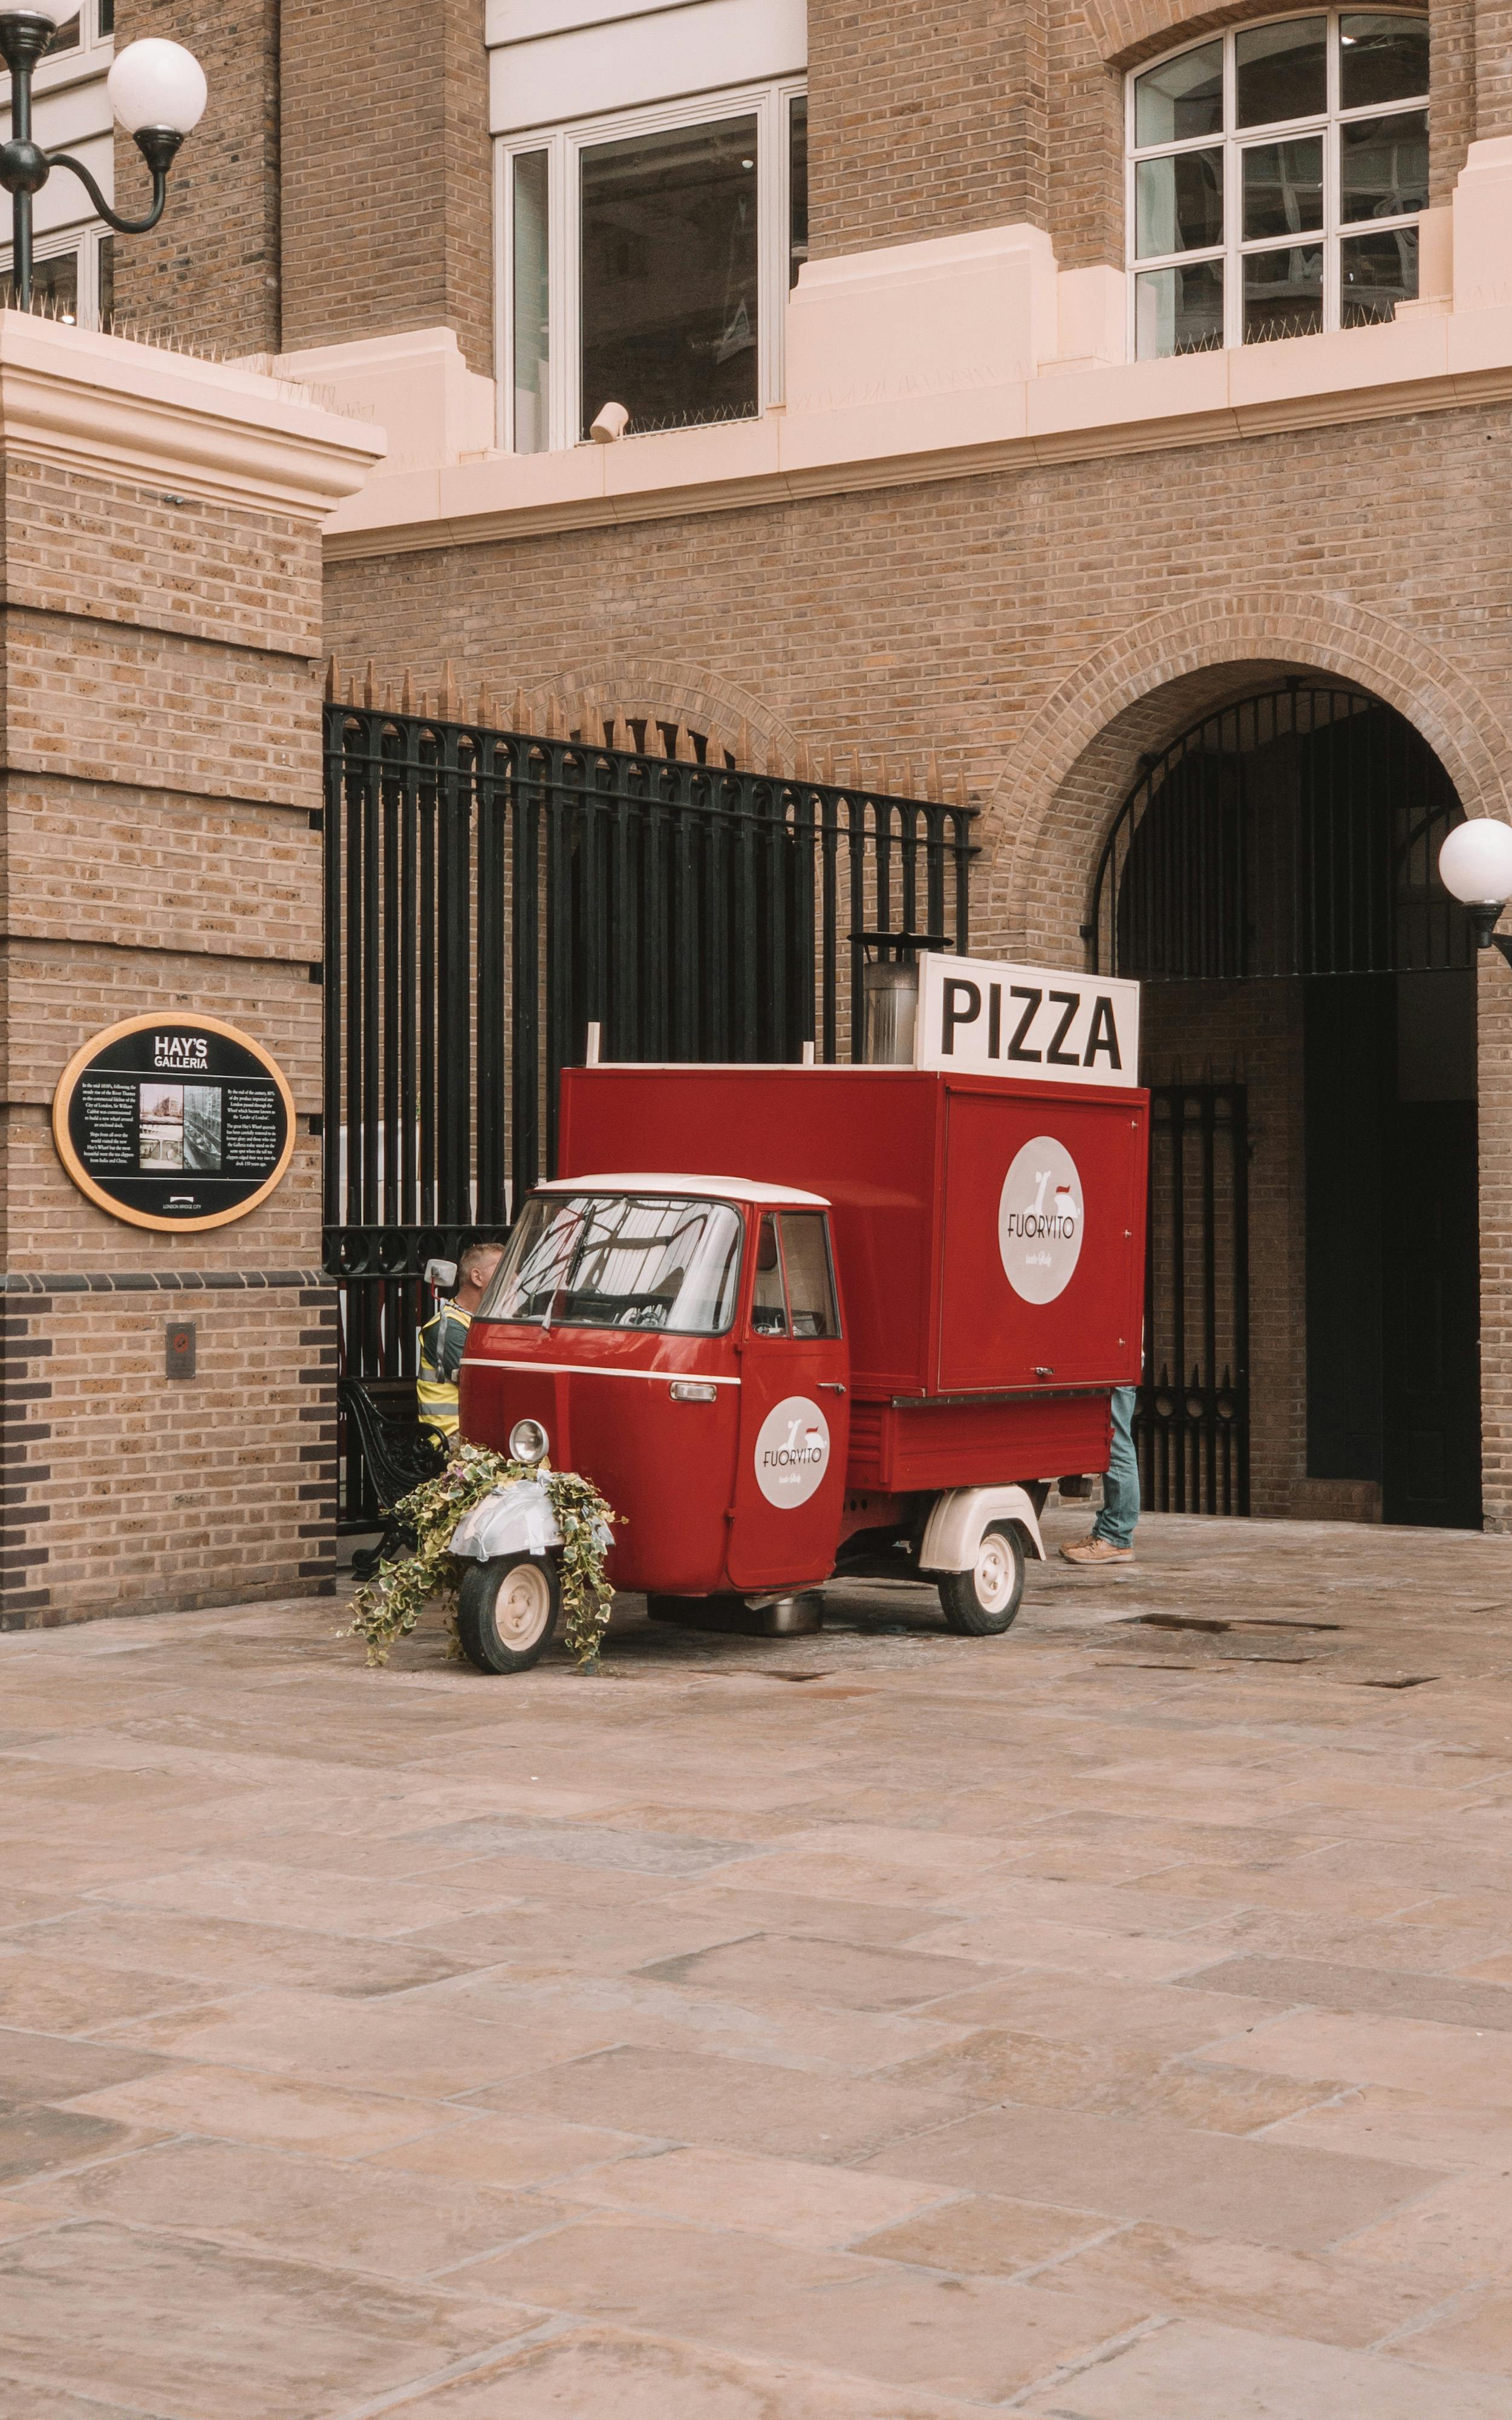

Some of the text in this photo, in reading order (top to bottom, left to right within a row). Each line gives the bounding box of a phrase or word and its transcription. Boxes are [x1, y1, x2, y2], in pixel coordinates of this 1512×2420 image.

[941, 977, 1122, 1070] PIZZA
[155, 1036, 207, 1058] HAY'S
[154, 1056, 208, 1069] GALLERIA
[1008, 1214, 1074, 1239] FUORVITO
[763, 1448, 821, 1467] FUORVITO
